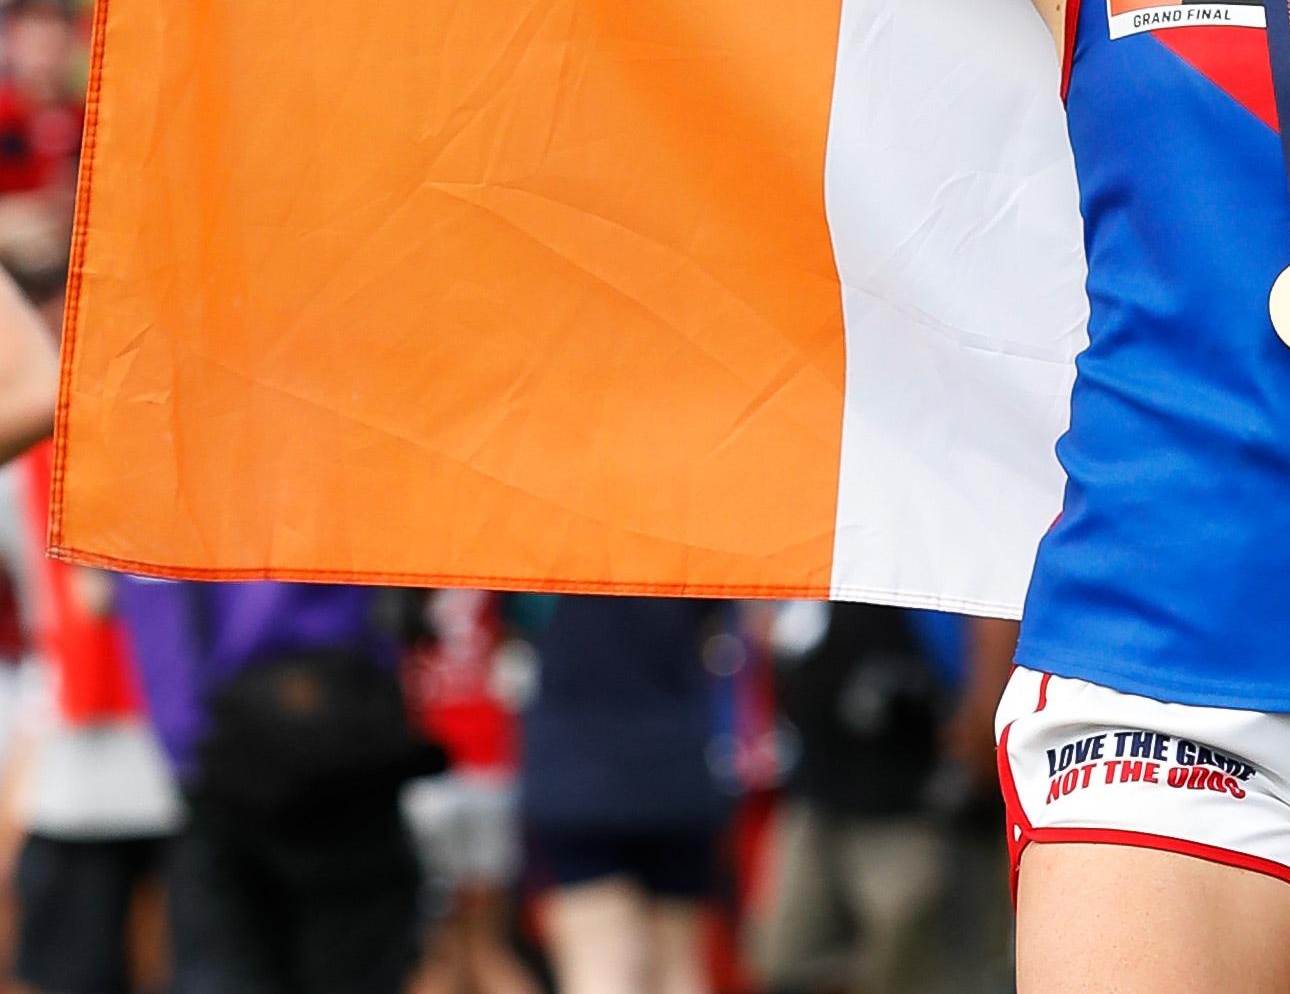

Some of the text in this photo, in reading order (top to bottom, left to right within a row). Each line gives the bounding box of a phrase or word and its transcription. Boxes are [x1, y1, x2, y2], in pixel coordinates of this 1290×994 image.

[1133, 9, 1231, 28] GRAND FINAL
[1046, 734, 1108, 779] LOVE
[1113, 731, 1171, 762] THE
[1045, 762, 1098, 806] NOT
[1103, 760, 1161, 785] THE
